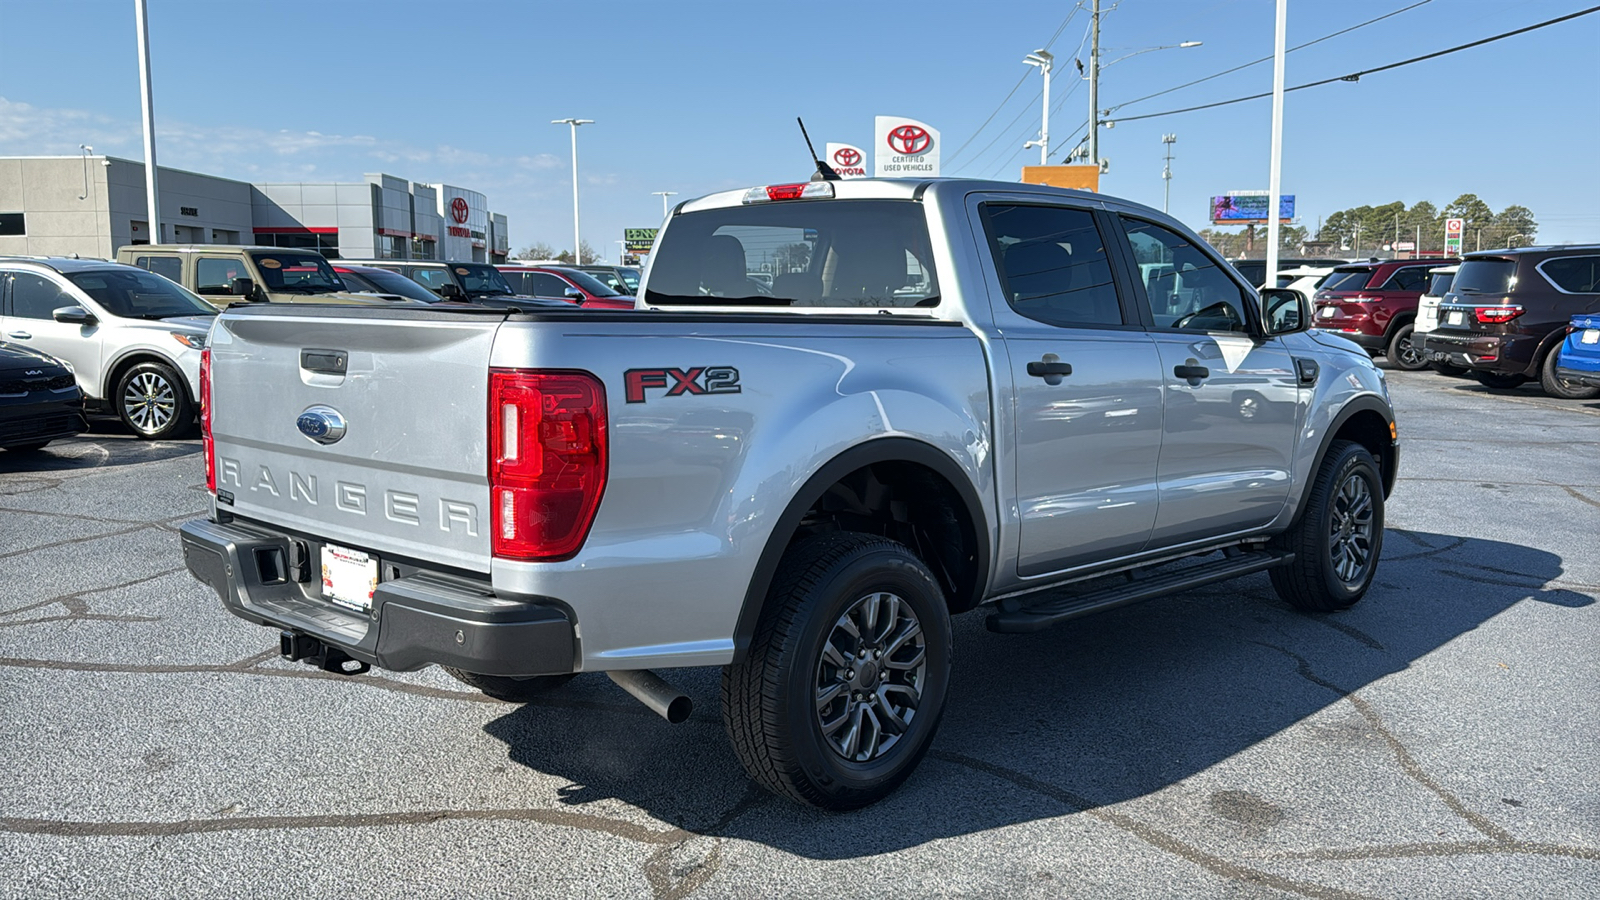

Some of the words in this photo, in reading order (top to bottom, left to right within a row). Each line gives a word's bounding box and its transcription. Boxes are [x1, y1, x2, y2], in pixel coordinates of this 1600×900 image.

[448, 226, 471, 238] TOYOTA
[622, 366, 742, 404] FX2
[218, 456, 480, 538] RANGER
